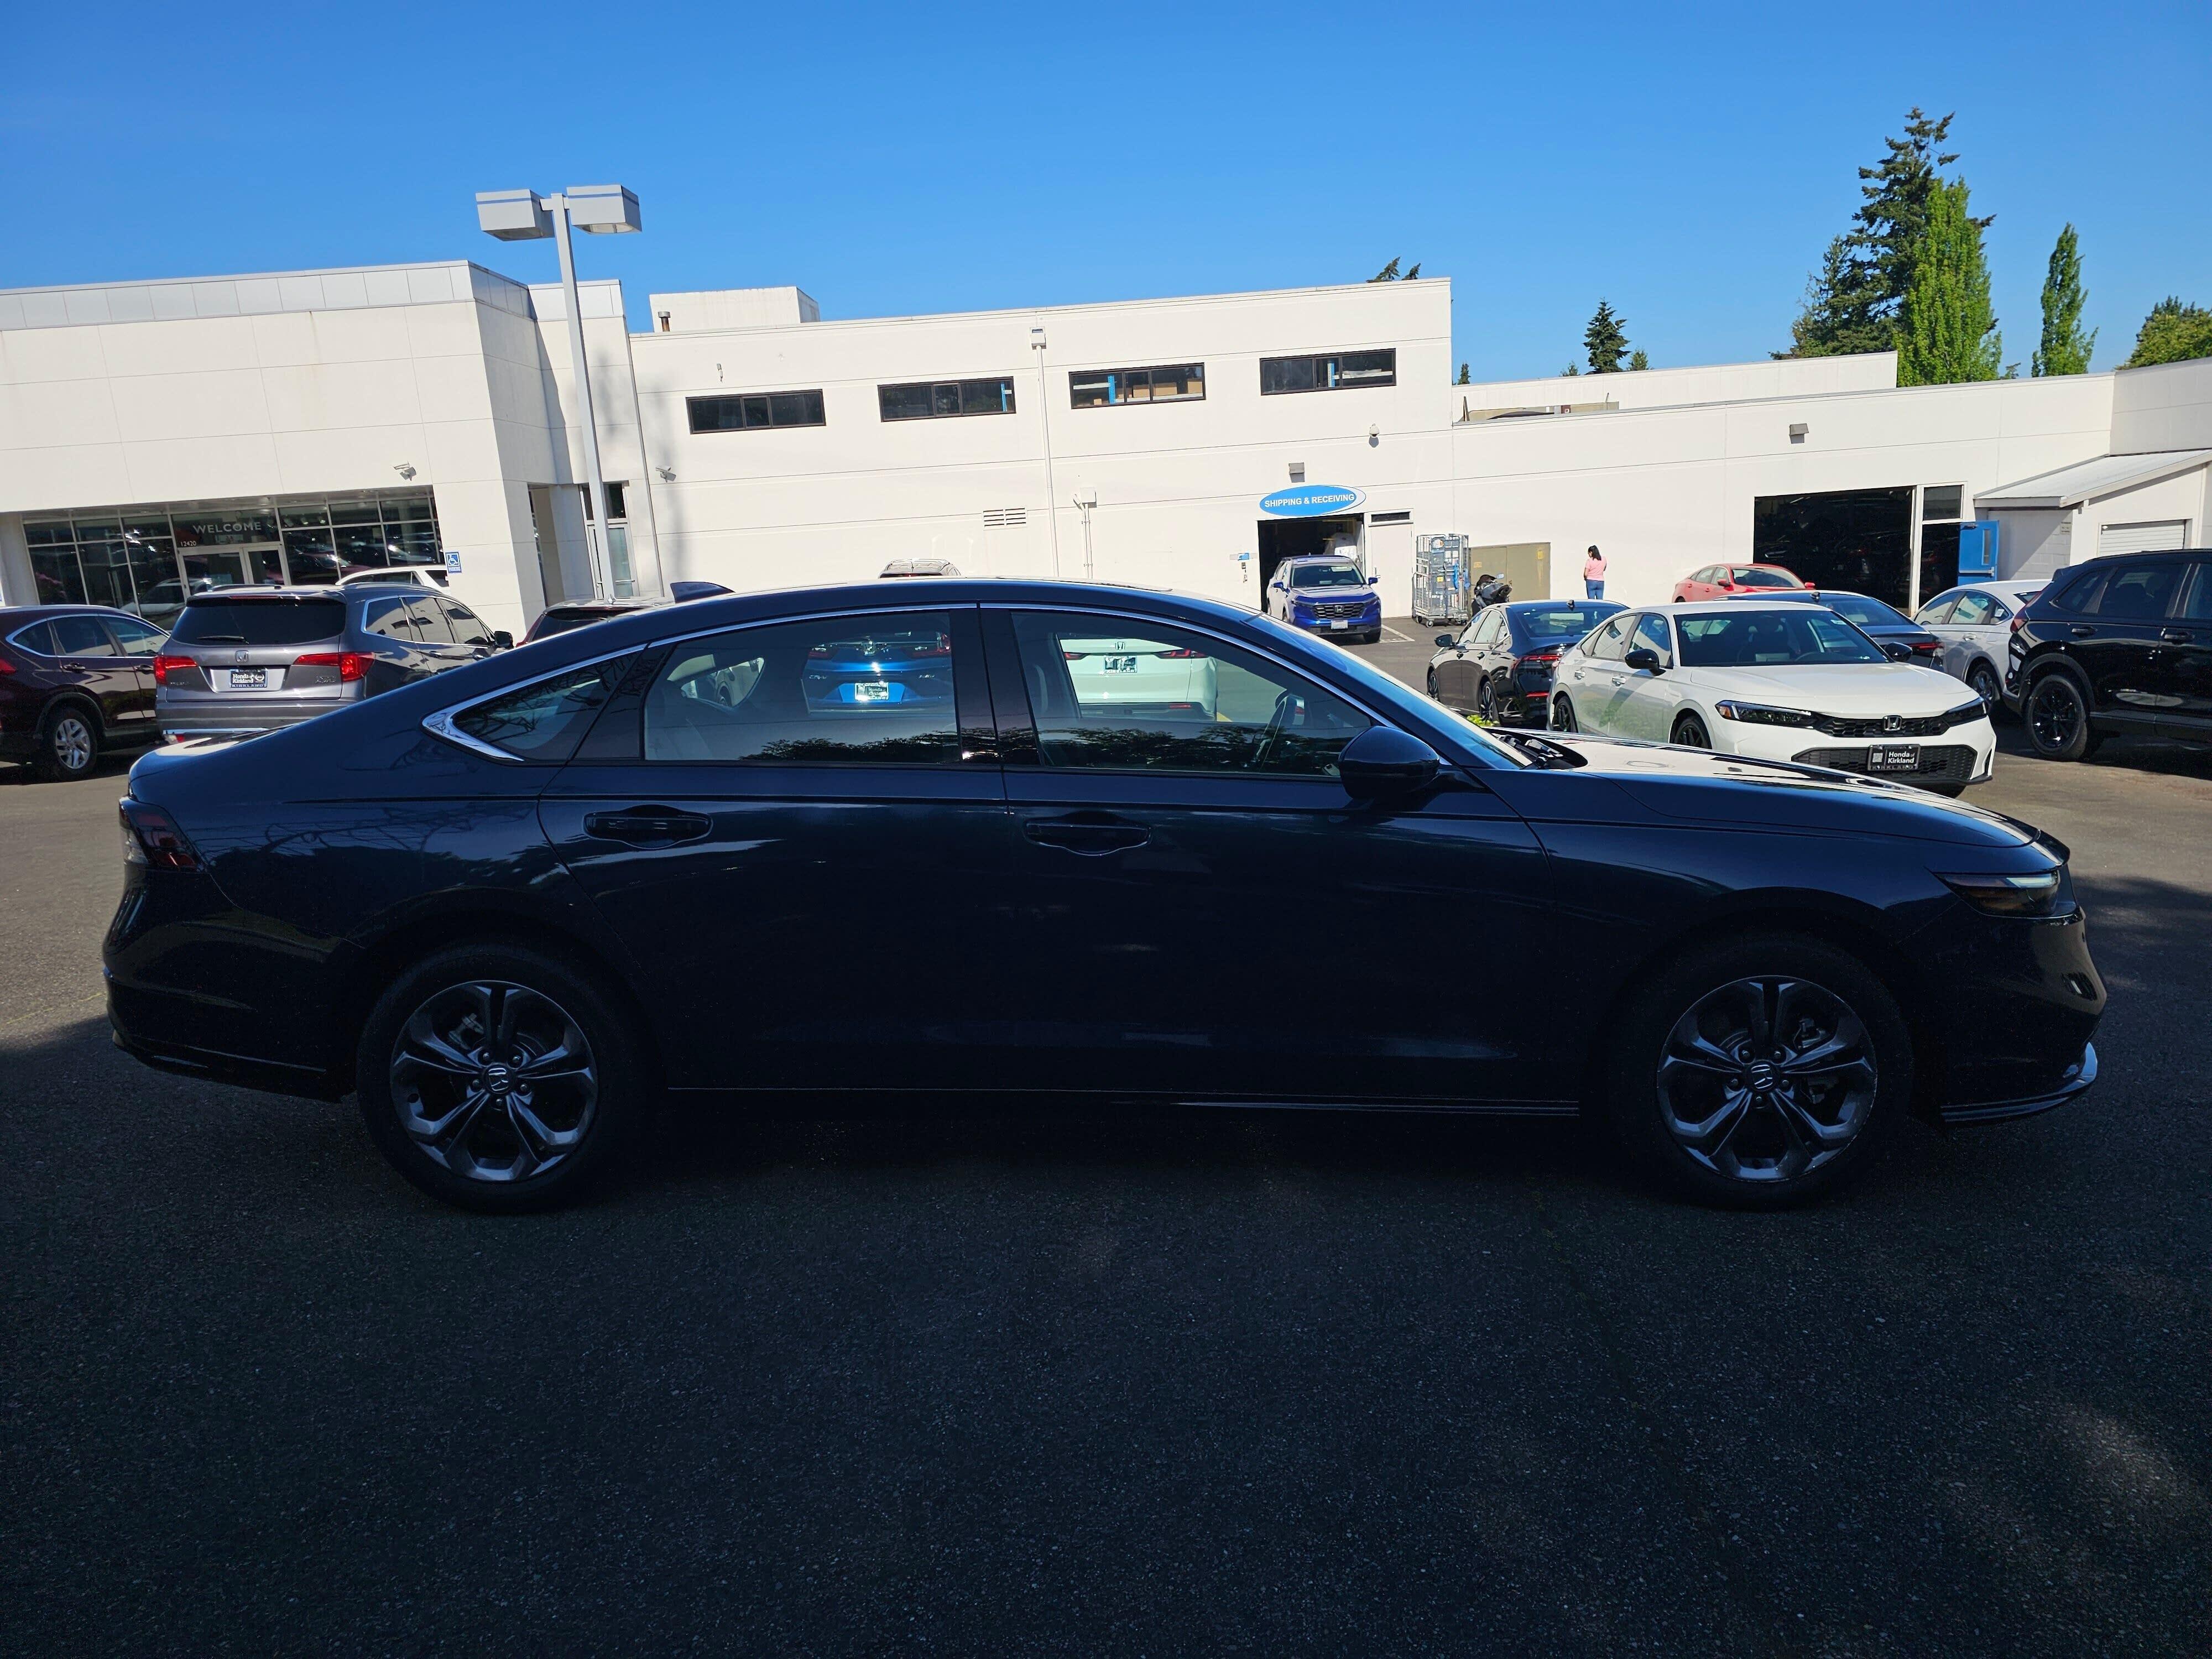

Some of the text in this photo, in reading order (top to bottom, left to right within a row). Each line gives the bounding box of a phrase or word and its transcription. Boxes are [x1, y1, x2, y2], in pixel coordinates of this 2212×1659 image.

[1265, 498, 1302, 507] SHIPPING
[1312, 493, 1354, 504] RECEIVING
[192, 521, 262, 534] WELCOME
